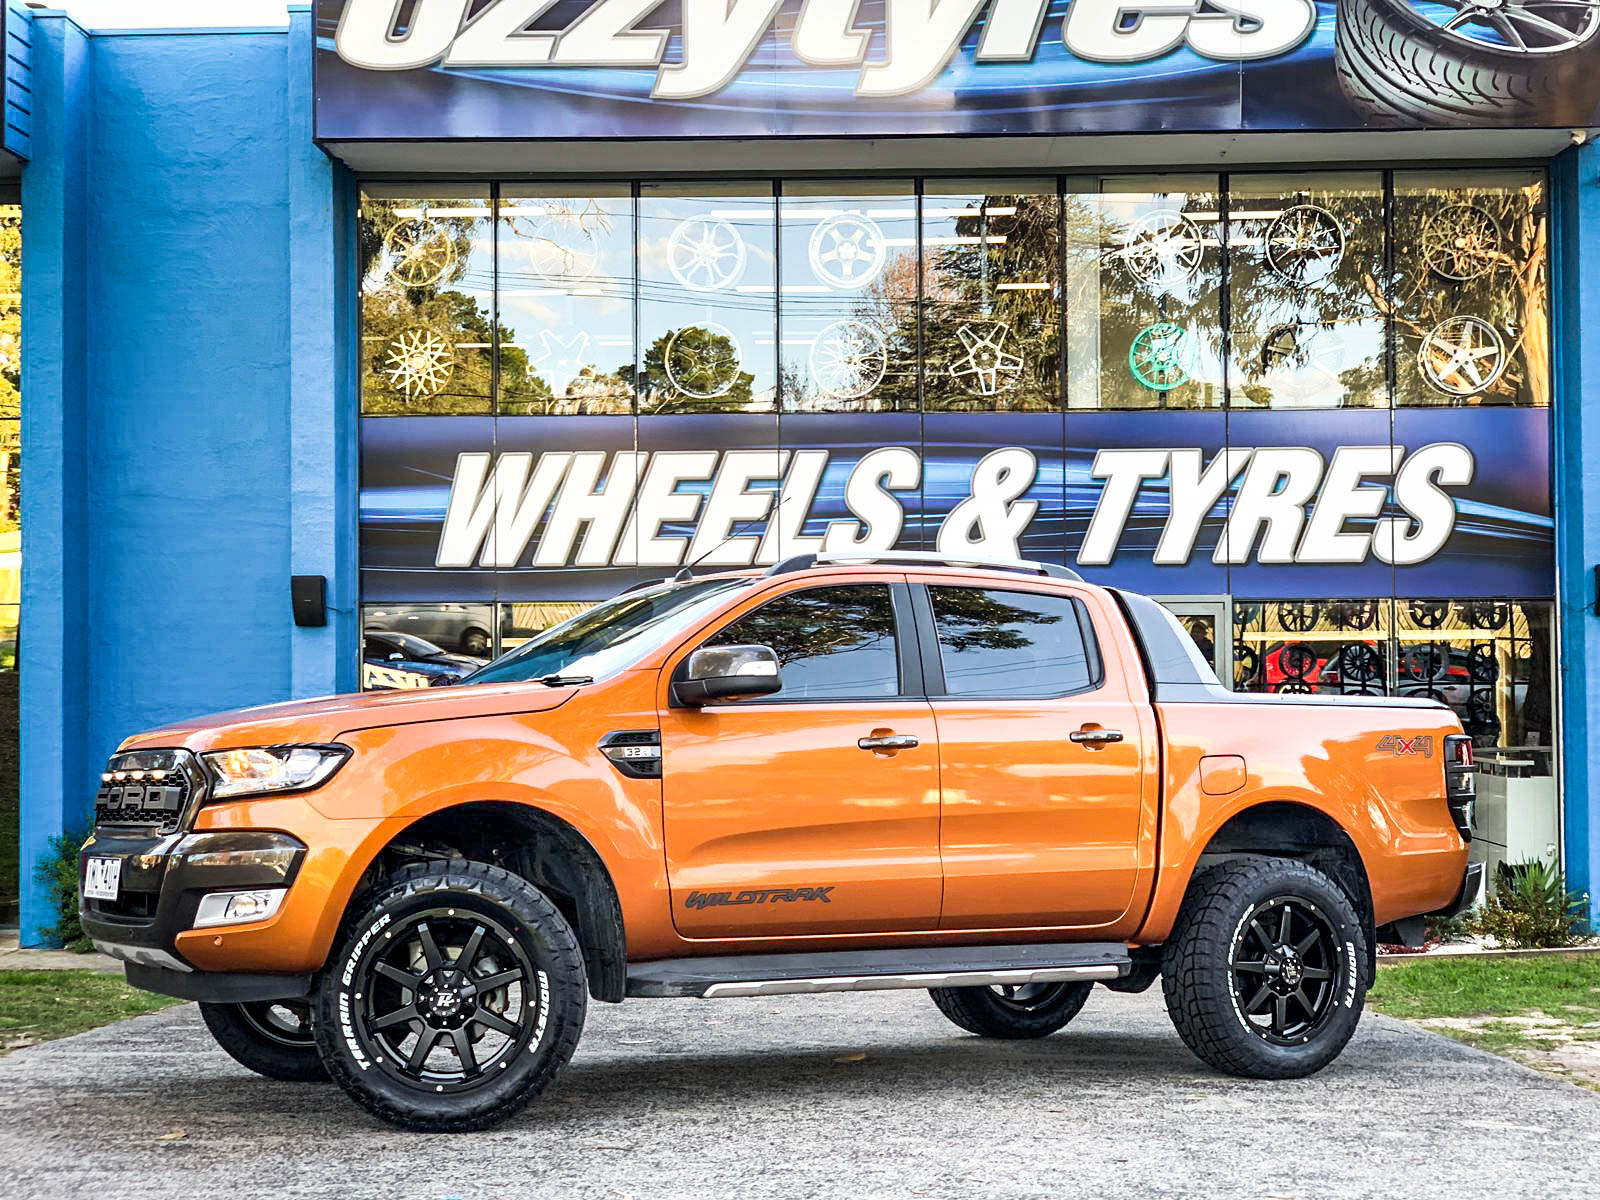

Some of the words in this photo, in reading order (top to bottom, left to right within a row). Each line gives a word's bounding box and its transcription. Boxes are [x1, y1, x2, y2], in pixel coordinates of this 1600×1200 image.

[435, 448, 922, 568] WHEELS
[936, 447, 1038, 563] &
[1075, 443, 1474, 566] TYRES
[685, 886, 835, 910] WILDTRAK
[342, 913, 391, 986] GRIPPER
